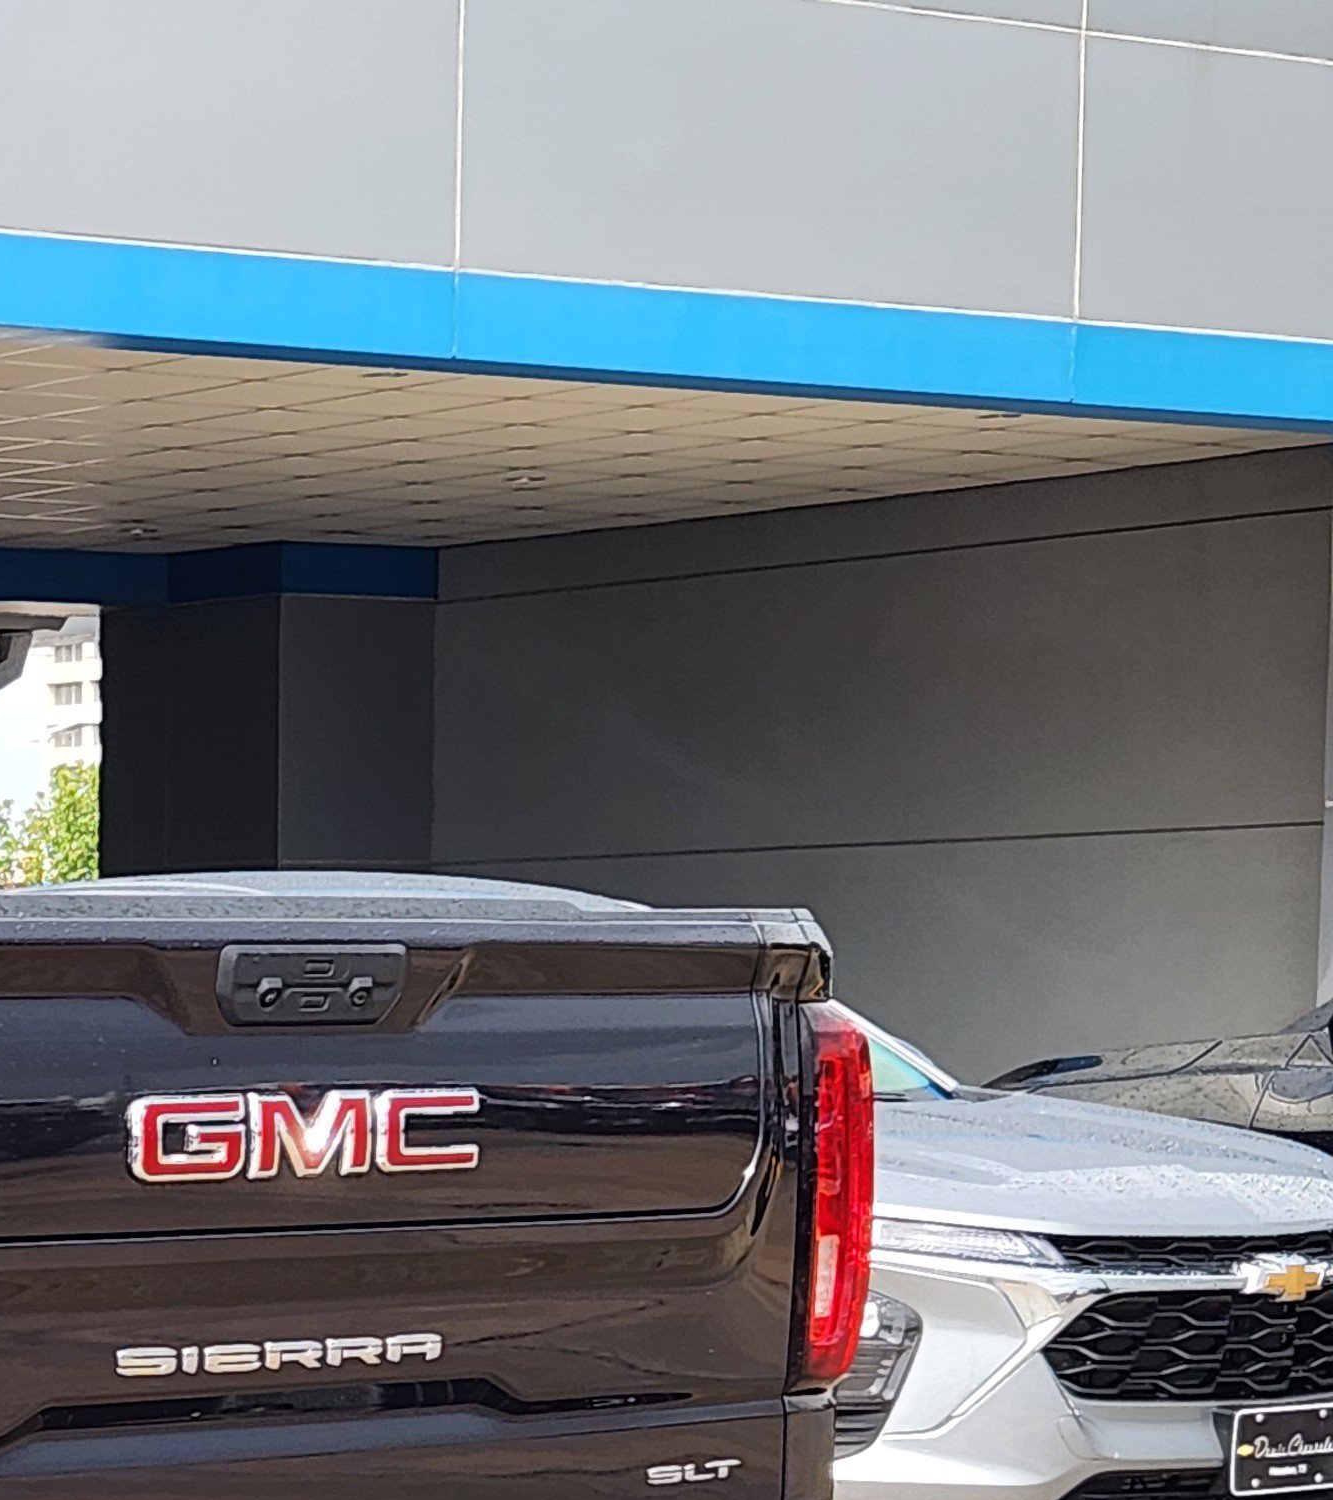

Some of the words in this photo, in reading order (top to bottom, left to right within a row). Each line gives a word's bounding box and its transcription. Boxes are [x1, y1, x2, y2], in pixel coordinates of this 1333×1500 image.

[128, 1089, 480, 1184] GMC
[115, 1332, 443, 1377] SIERRA
[646, 1458, 742, 1485] SLT
